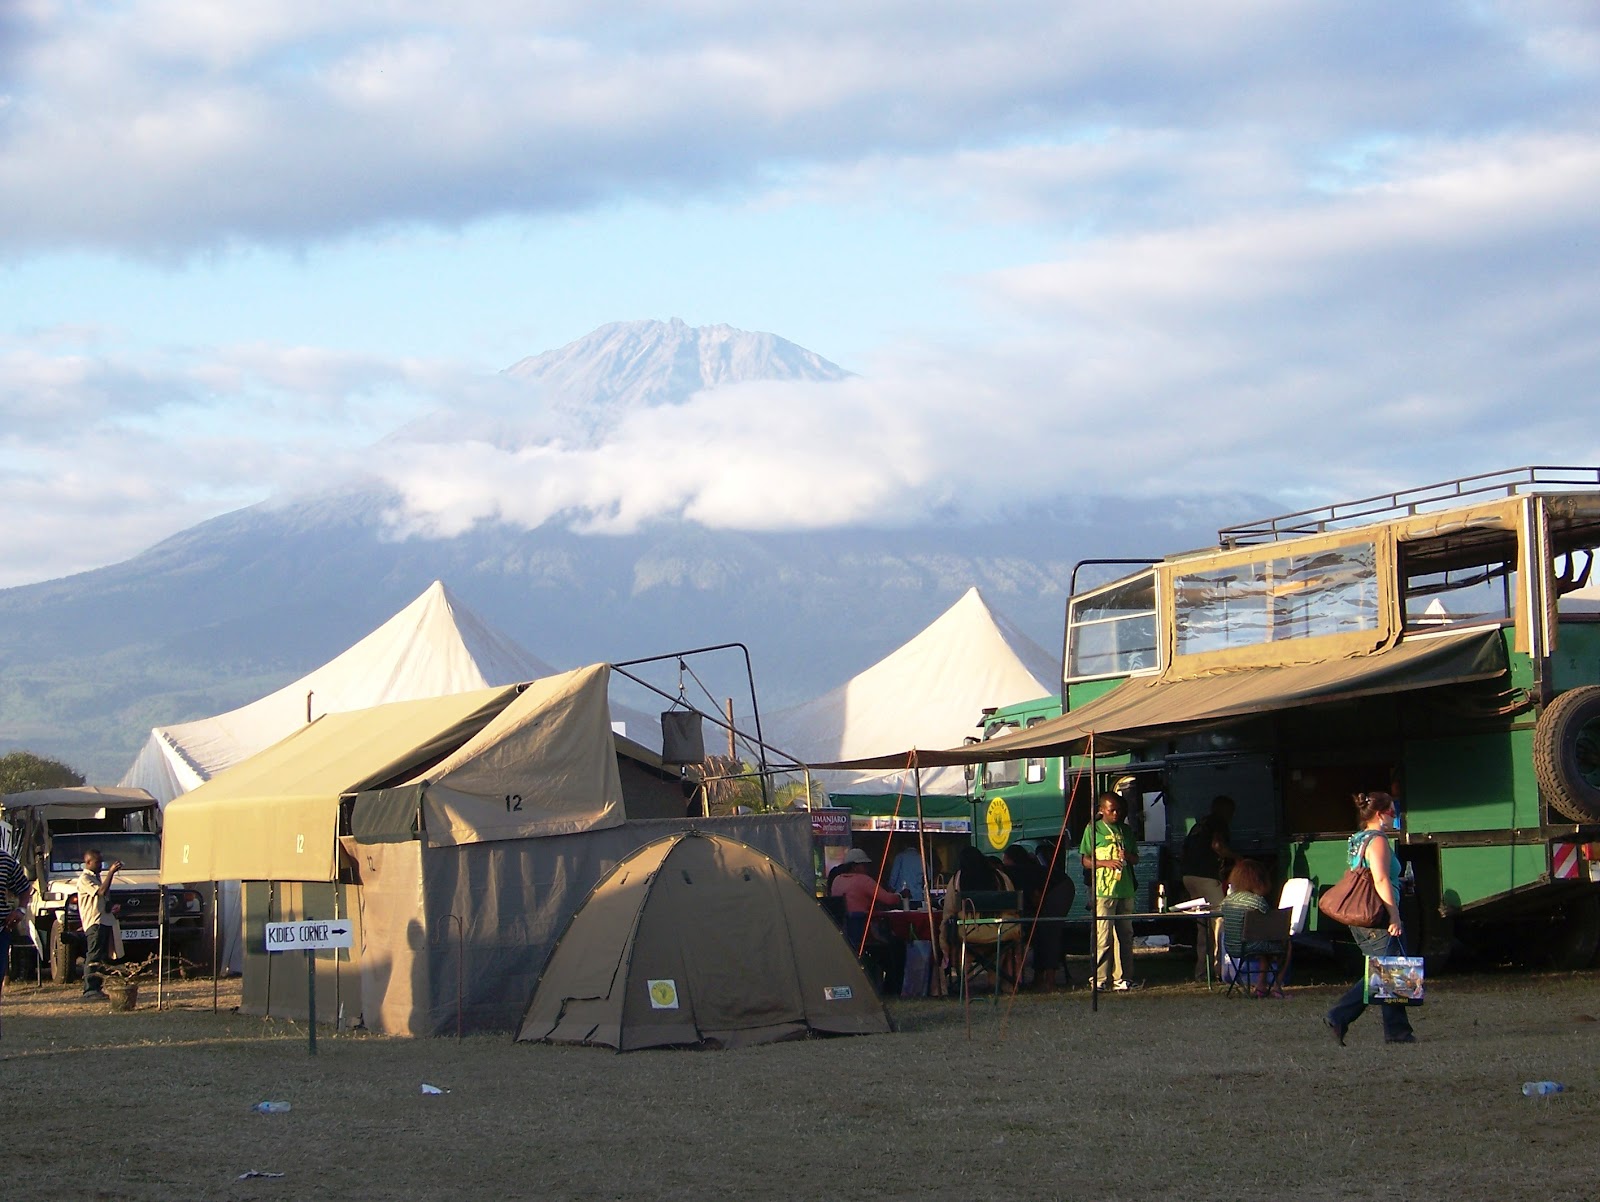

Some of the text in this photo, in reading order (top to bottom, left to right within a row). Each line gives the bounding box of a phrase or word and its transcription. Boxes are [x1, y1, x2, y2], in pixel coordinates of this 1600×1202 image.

[505, 795, 522, 812] 12
[296, 834, 304, 853] 12
[183, 844, 190, 864] 12
[268, 925, 329, 943] KIDIES CORNER
